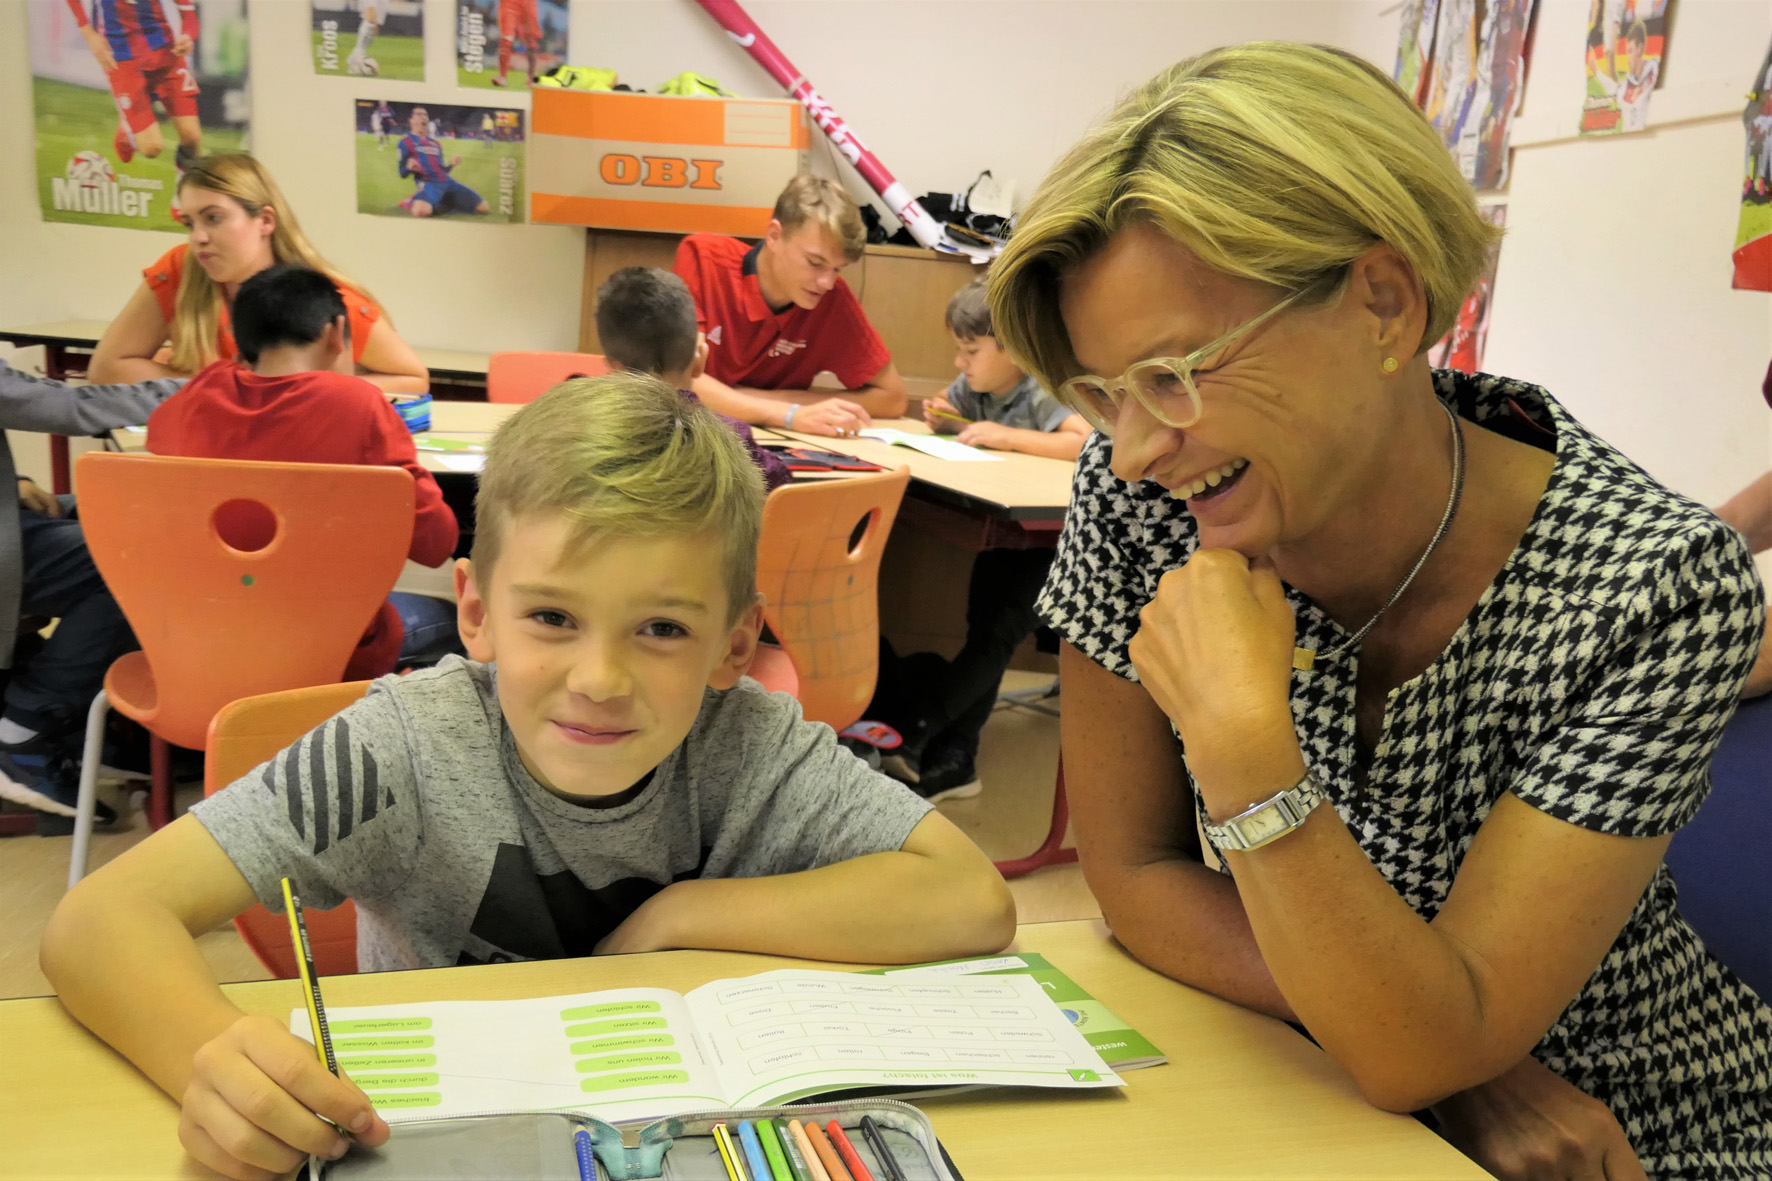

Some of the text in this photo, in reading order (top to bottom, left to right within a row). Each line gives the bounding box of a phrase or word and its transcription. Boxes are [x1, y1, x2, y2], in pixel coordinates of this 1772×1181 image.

[321, 20, 339, 70] Kroos
[464, 13, 486, 73] Stegen
[600, 153, 723, 190] OBI
[51, 176, 153, 217] Müller
[749, 1007, 772, 1016] Dose
[592, 1039, 646, 1049] schwimmen
[1094, 1041, 1127, 1051] weste
[764, 1052, 803, 1064] schlafen
[352, 1078, 379, 1086] Berg
[399, 1077, 428, 1085] durch
[618, 1075, 660, 1084] wandern
